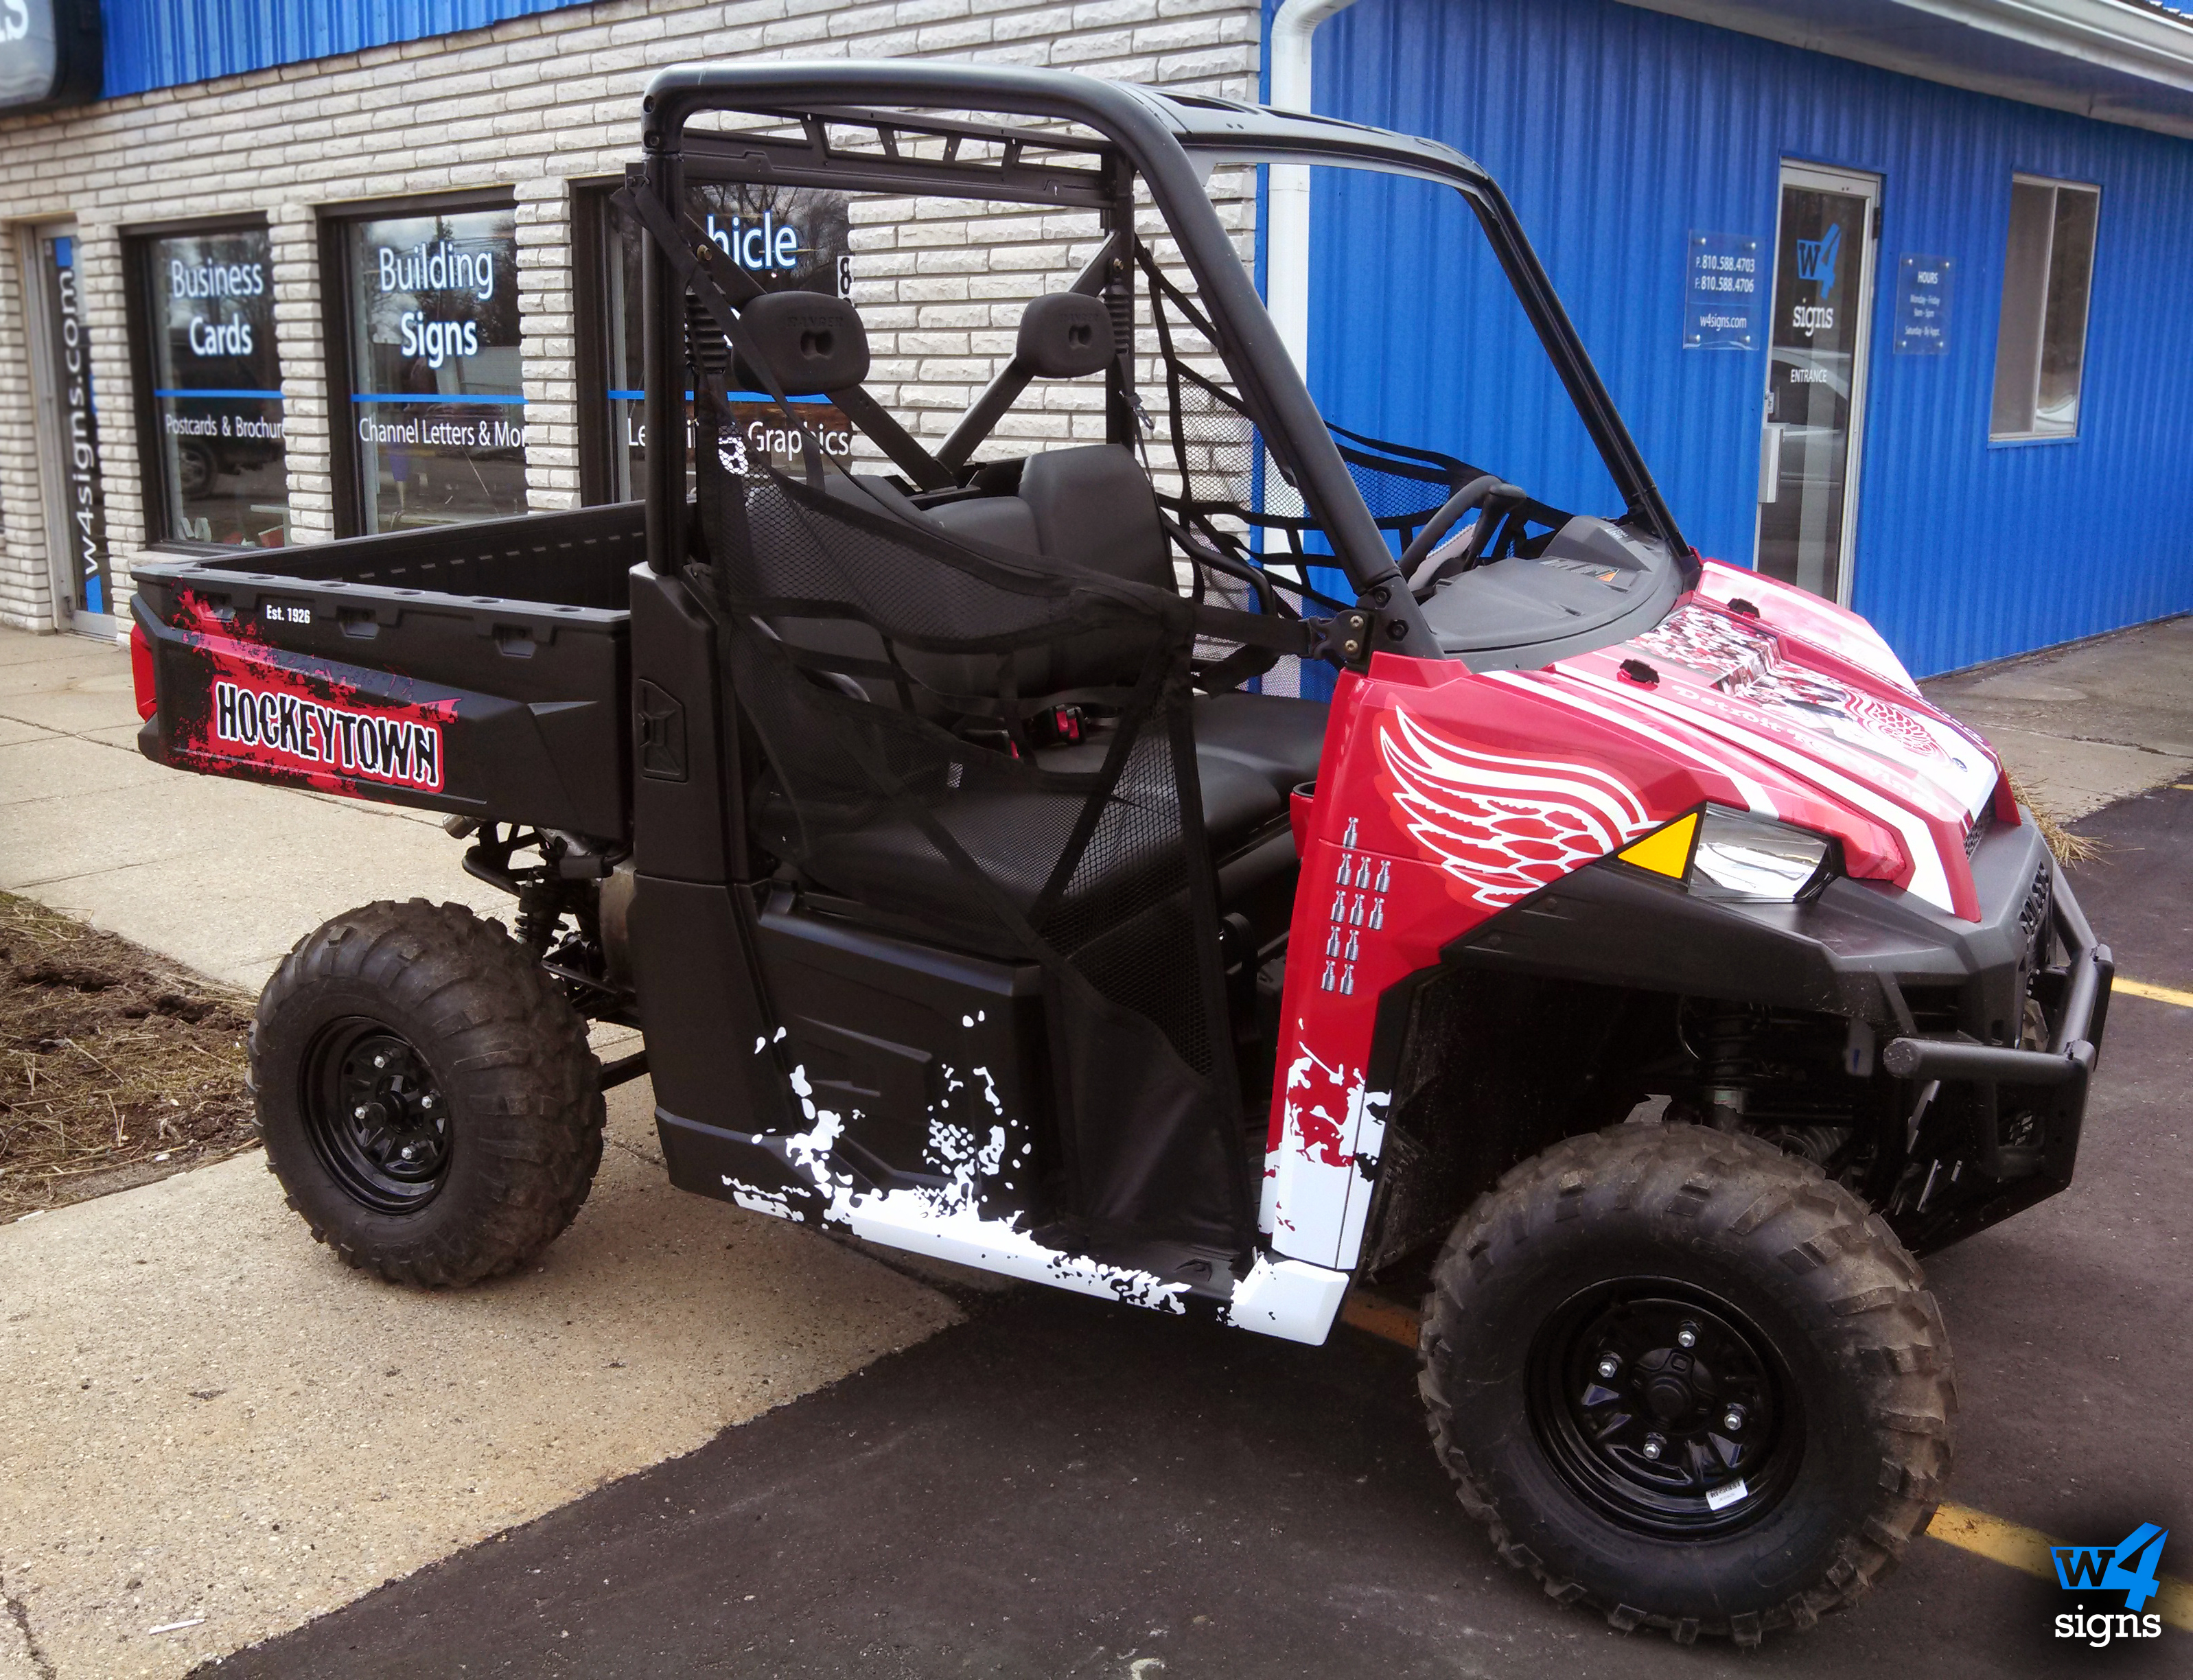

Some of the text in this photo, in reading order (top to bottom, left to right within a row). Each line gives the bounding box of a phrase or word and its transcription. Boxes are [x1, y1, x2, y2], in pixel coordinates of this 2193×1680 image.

[707, 210, 798, 270] hicle
[171, 257, 264, 298] Business
[379, 240, 494, 301] Building
[1917, 271, 1938, 284] HOURS
[189, 312, 253, 356] Cards
[1700, 313, 1747, 331] w4signs.com
[1792, 297, 1833, 336] signs
[400, 311, 478, 369] Signs
[1790, 369, 1827, 384] ENTRANCE
[60, 270, 98, 575] w4signs.com
[165, 414, 218, 436] Postcards
[221, 415, 231, 437] &
[359, 411, 419, 443] Channel
[422, 419, 475, 446] Letters
[478, 420, 491, 446] &
[266, 604, 310, 624] Est. 1926
[215, 681, 439, 788] HOCKEYTOWN
